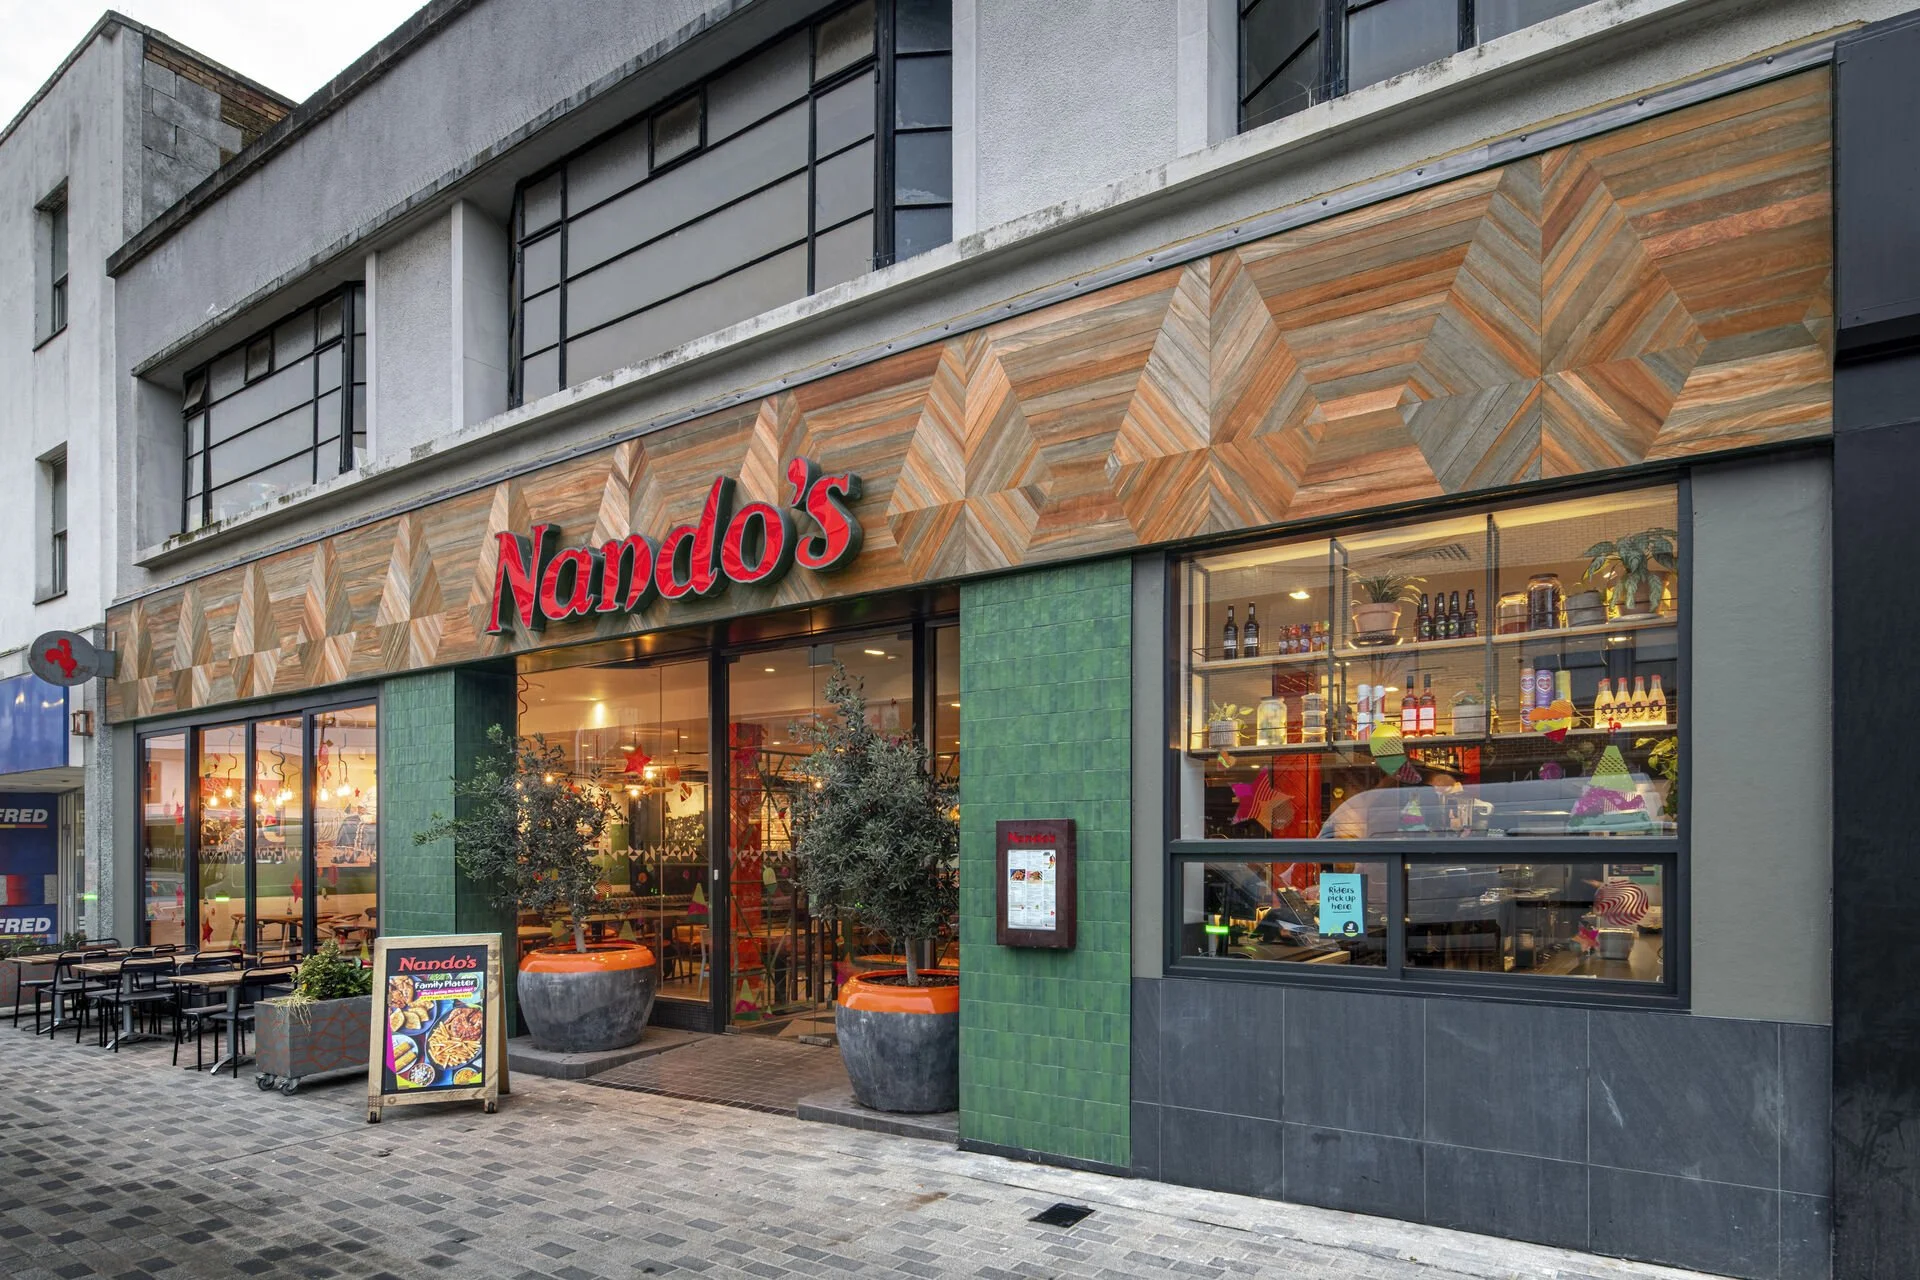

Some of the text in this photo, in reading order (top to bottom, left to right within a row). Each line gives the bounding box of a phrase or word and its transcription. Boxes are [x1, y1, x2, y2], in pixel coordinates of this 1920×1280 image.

[485, 457, 862, 637] Nando's
[1328, 886, 1355, 894] Riders
[1327, 893, 1356, 903] pick up
[397, 954, 477, 972] Nando's
[414, 979, 474, 990] Family Platter
